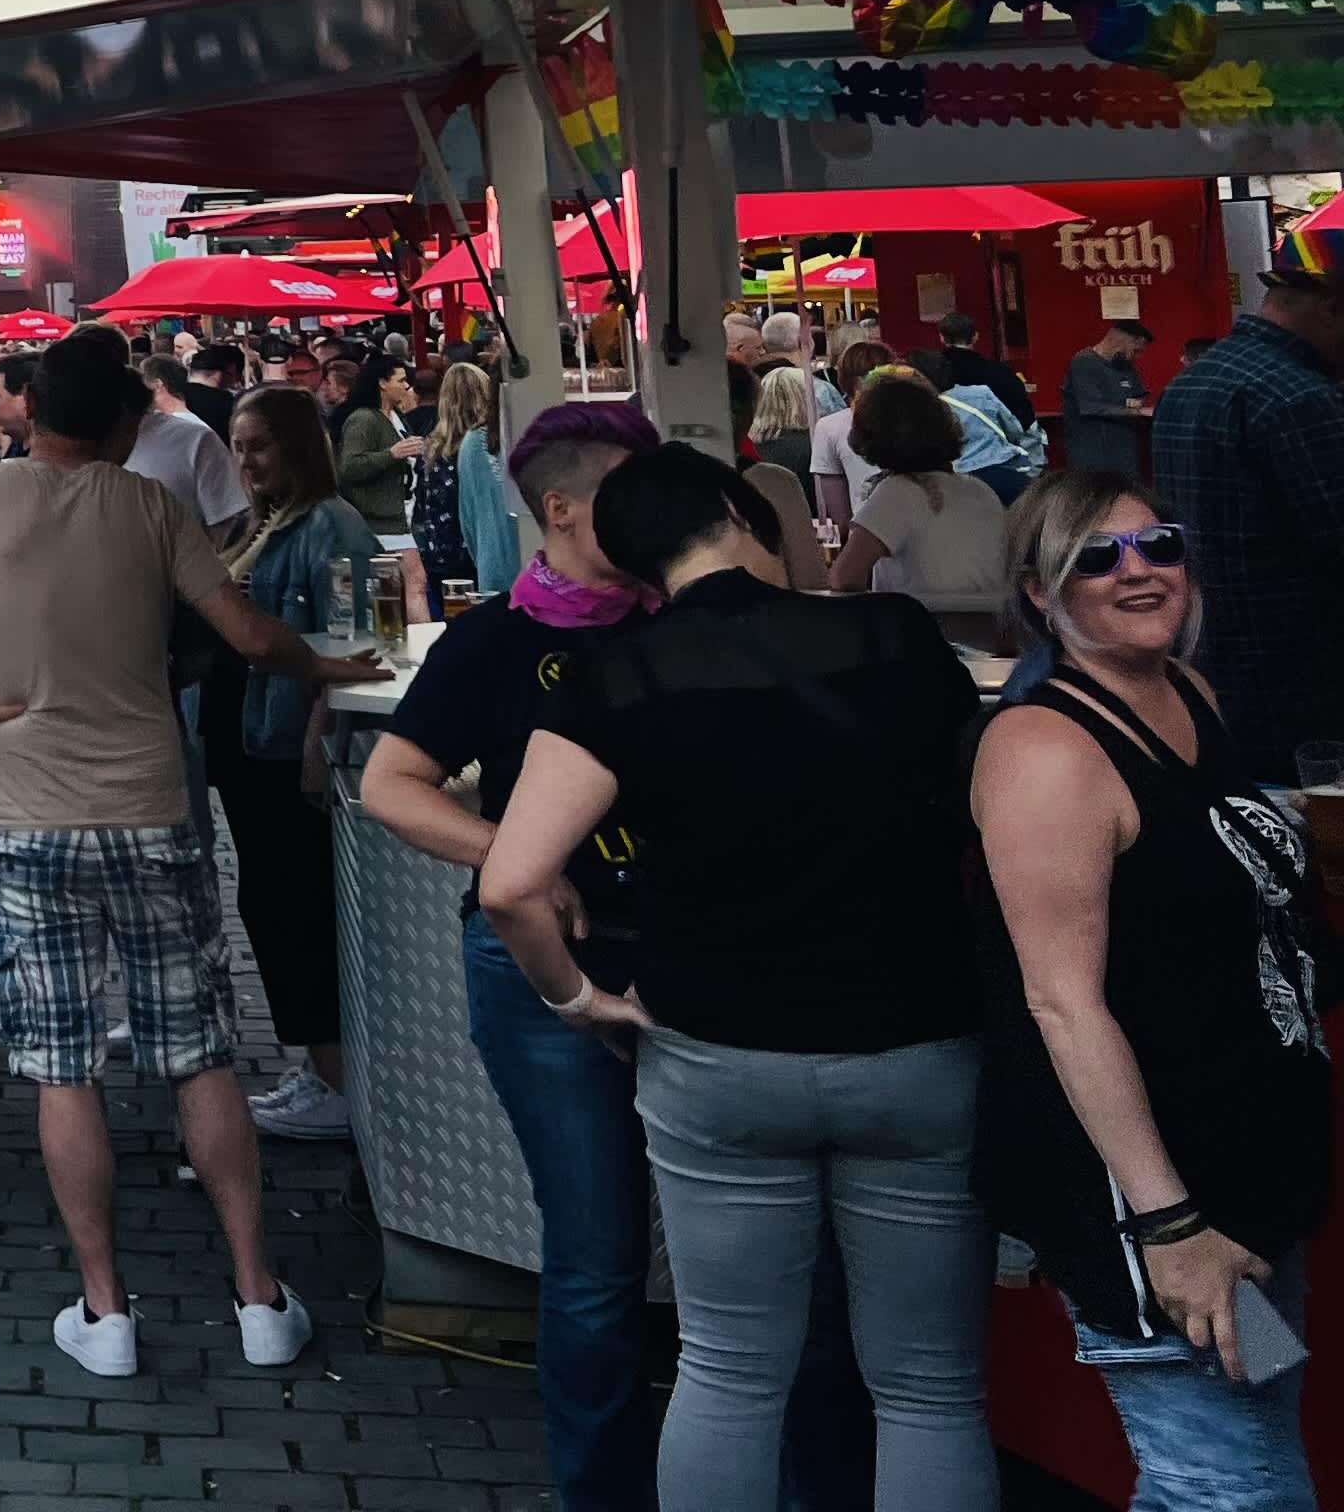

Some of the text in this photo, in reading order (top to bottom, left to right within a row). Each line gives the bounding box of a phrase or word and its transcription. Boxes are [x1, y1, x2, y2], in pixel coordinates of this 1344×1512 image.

[1052, 219, 1175, 274] früh
[0, 253, 24, 264] EASY
[1085, 272, 1152, 286] KÖLSCH
